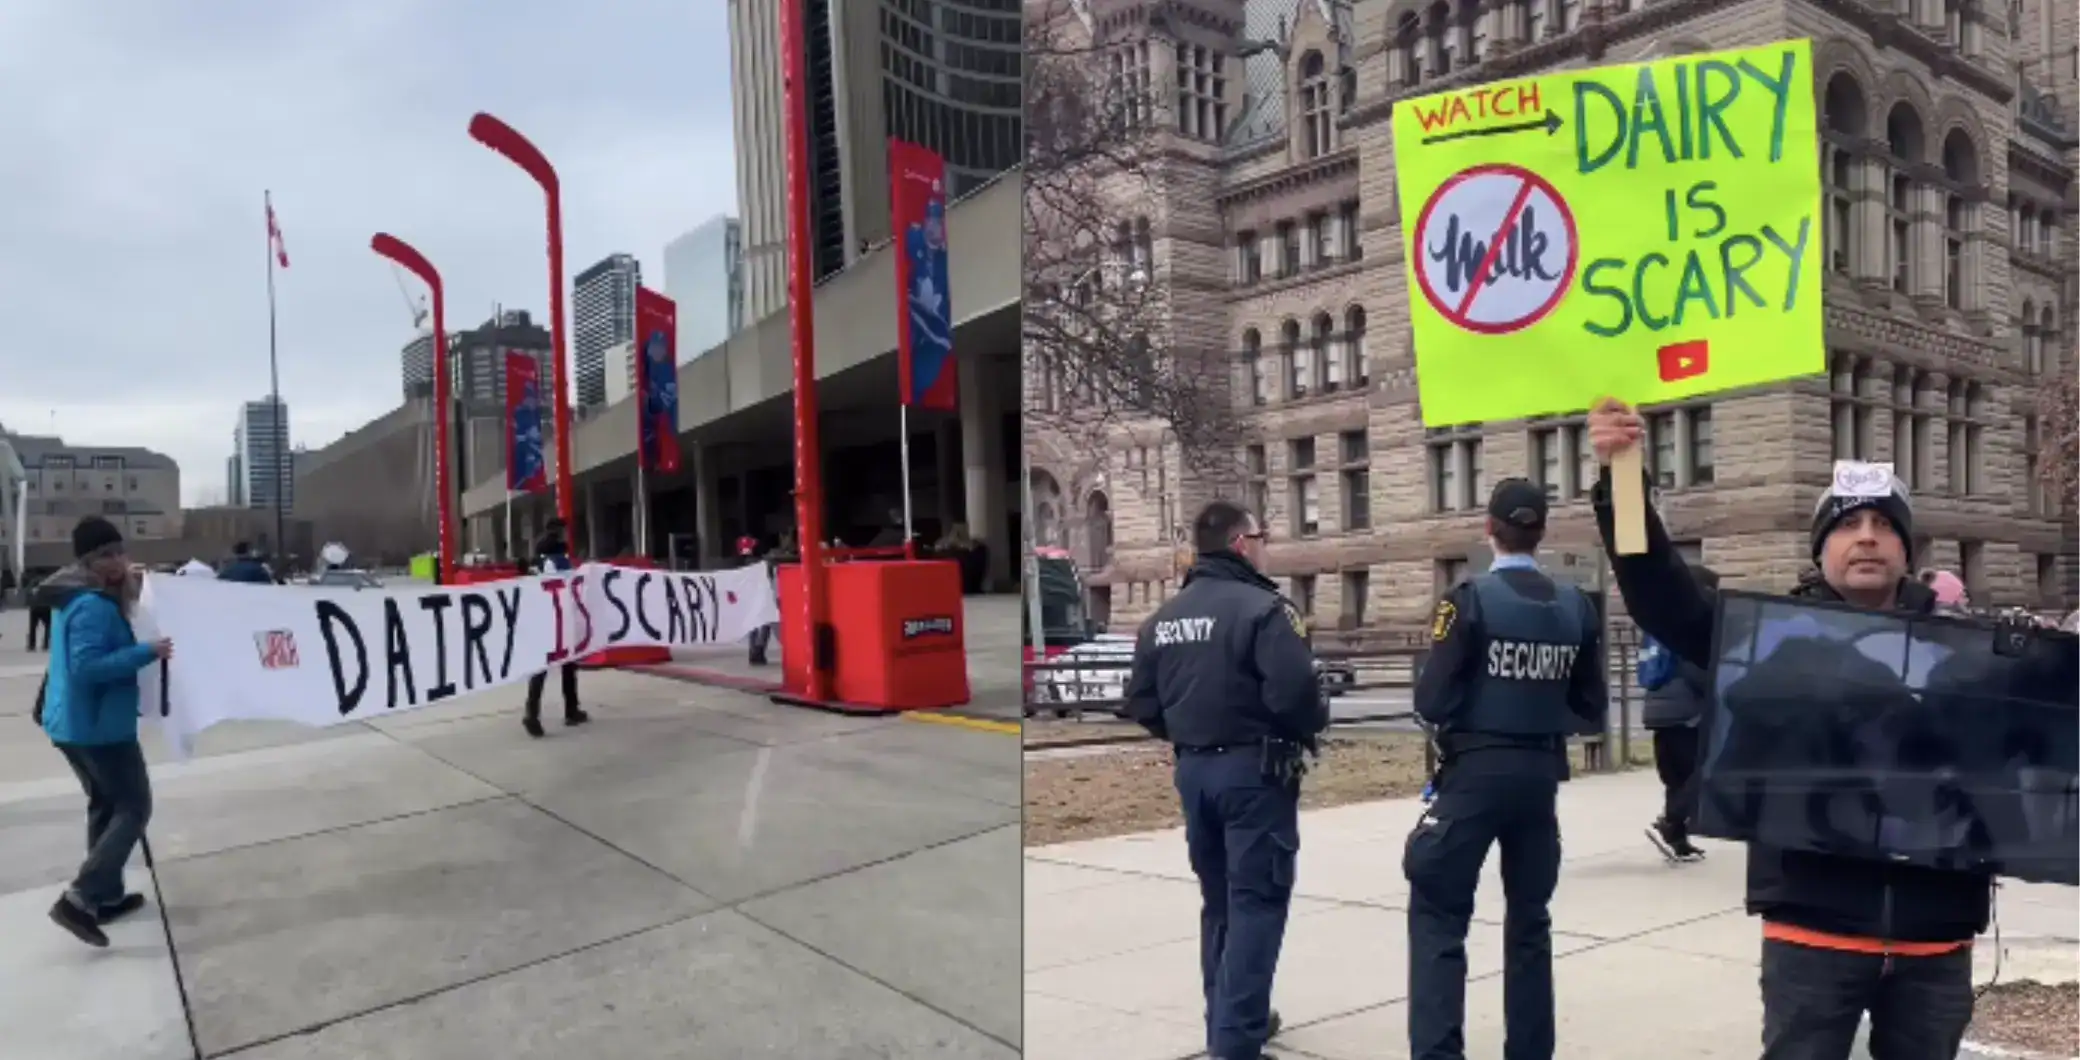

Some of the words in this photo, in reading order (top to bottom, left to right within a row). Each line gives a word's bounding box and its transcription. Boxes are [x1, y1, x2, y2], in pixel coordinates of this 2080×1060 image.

[1414, 82, 1541, 132] WATCH
[1573, 51, 1795, 174] DAIRY
[1665, 180, 1727, 241] IS
[1581, 215, 1810, 338] SCARY
[315, 587, 521, 715] DAIRY
[541, 575, 592, 664] IS
[1487, 639, 1580, 680] SECURITY
